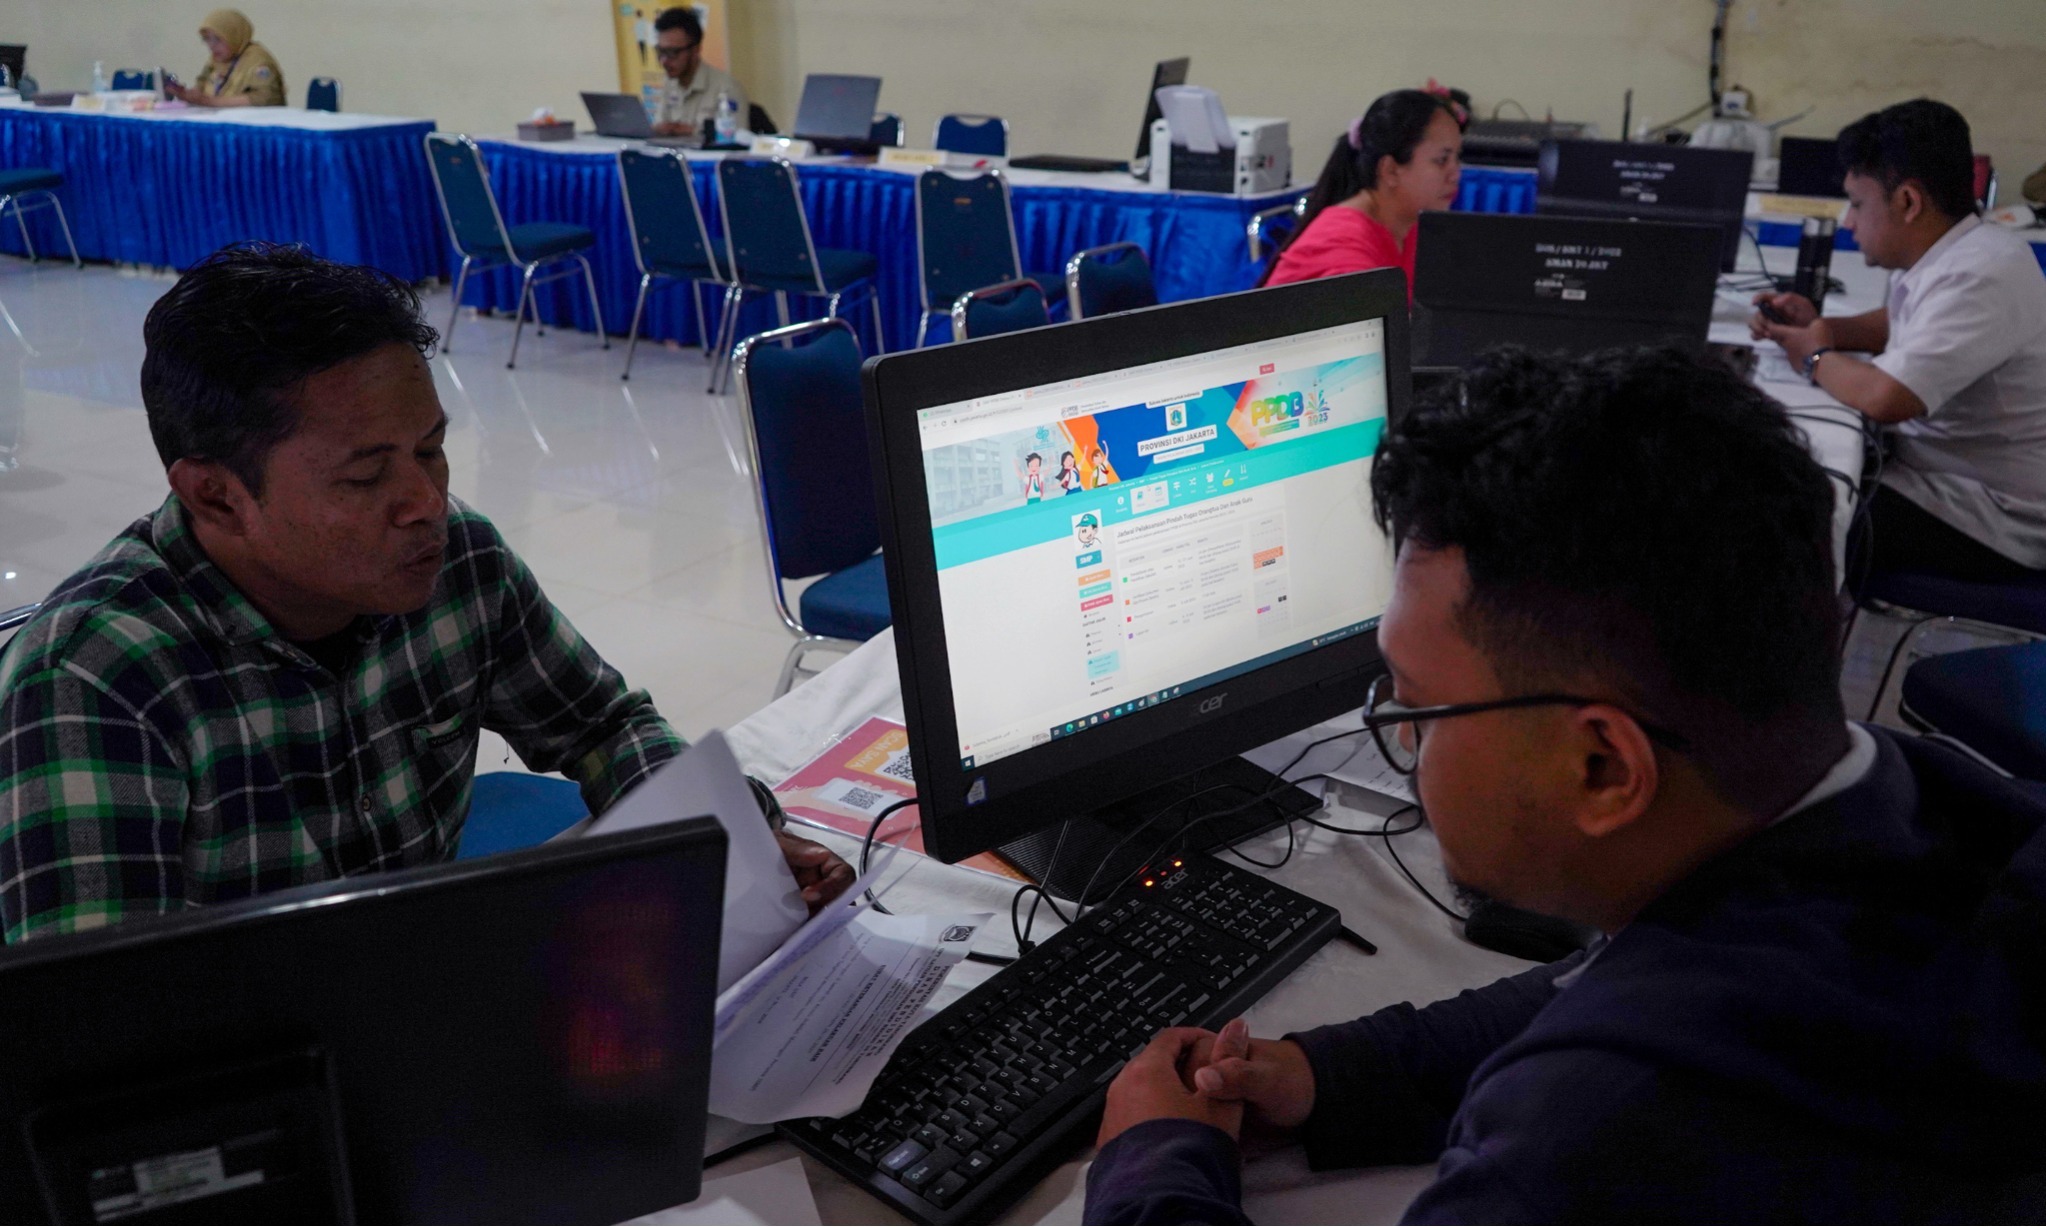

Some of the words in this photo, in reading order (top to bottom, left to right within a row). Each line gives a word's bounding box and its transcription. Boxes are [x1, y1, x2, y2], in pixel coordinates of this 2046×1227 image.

[1251, 391, 1304, 427] PPDB
[1140, 438, 1172, 452] PROVINSI
[1172, 436, 1184, 445] DKI
[1185, 428, 1215, 442] JAKARTA
[1166, 515, 1183, 525] Pindah
[1183, 511, 1198, 522] Tugas
[1198, 692, 1229, 714] cer
[1161, 868, 1189, 890] acer
